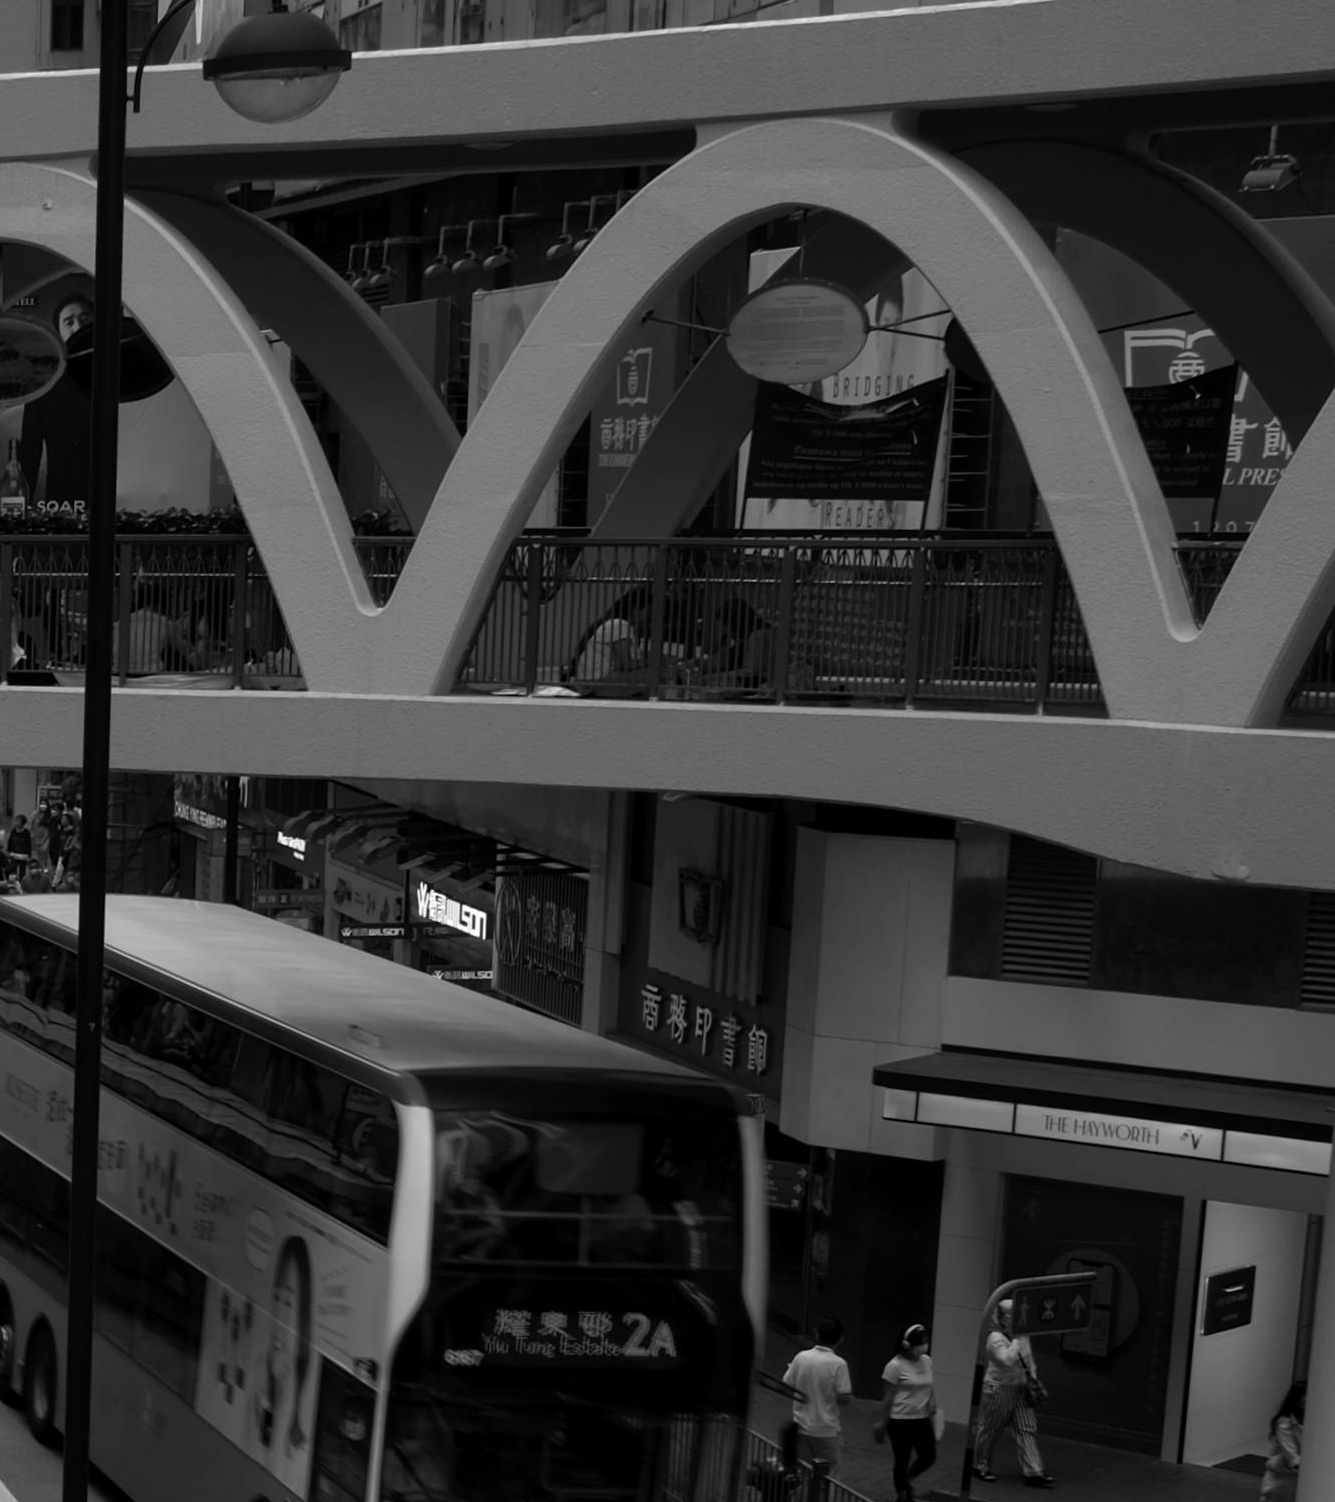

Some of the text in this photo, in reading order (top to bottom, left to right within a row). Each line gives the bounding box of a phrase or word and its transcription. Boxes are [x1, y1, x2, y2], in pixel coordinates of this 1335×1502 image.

[641, 983, 769, 1075] 商務印書館
[1043, 1114, 1160, 1145] THE HAYWORTH
[621, 1311, 677, 1359] 2A
